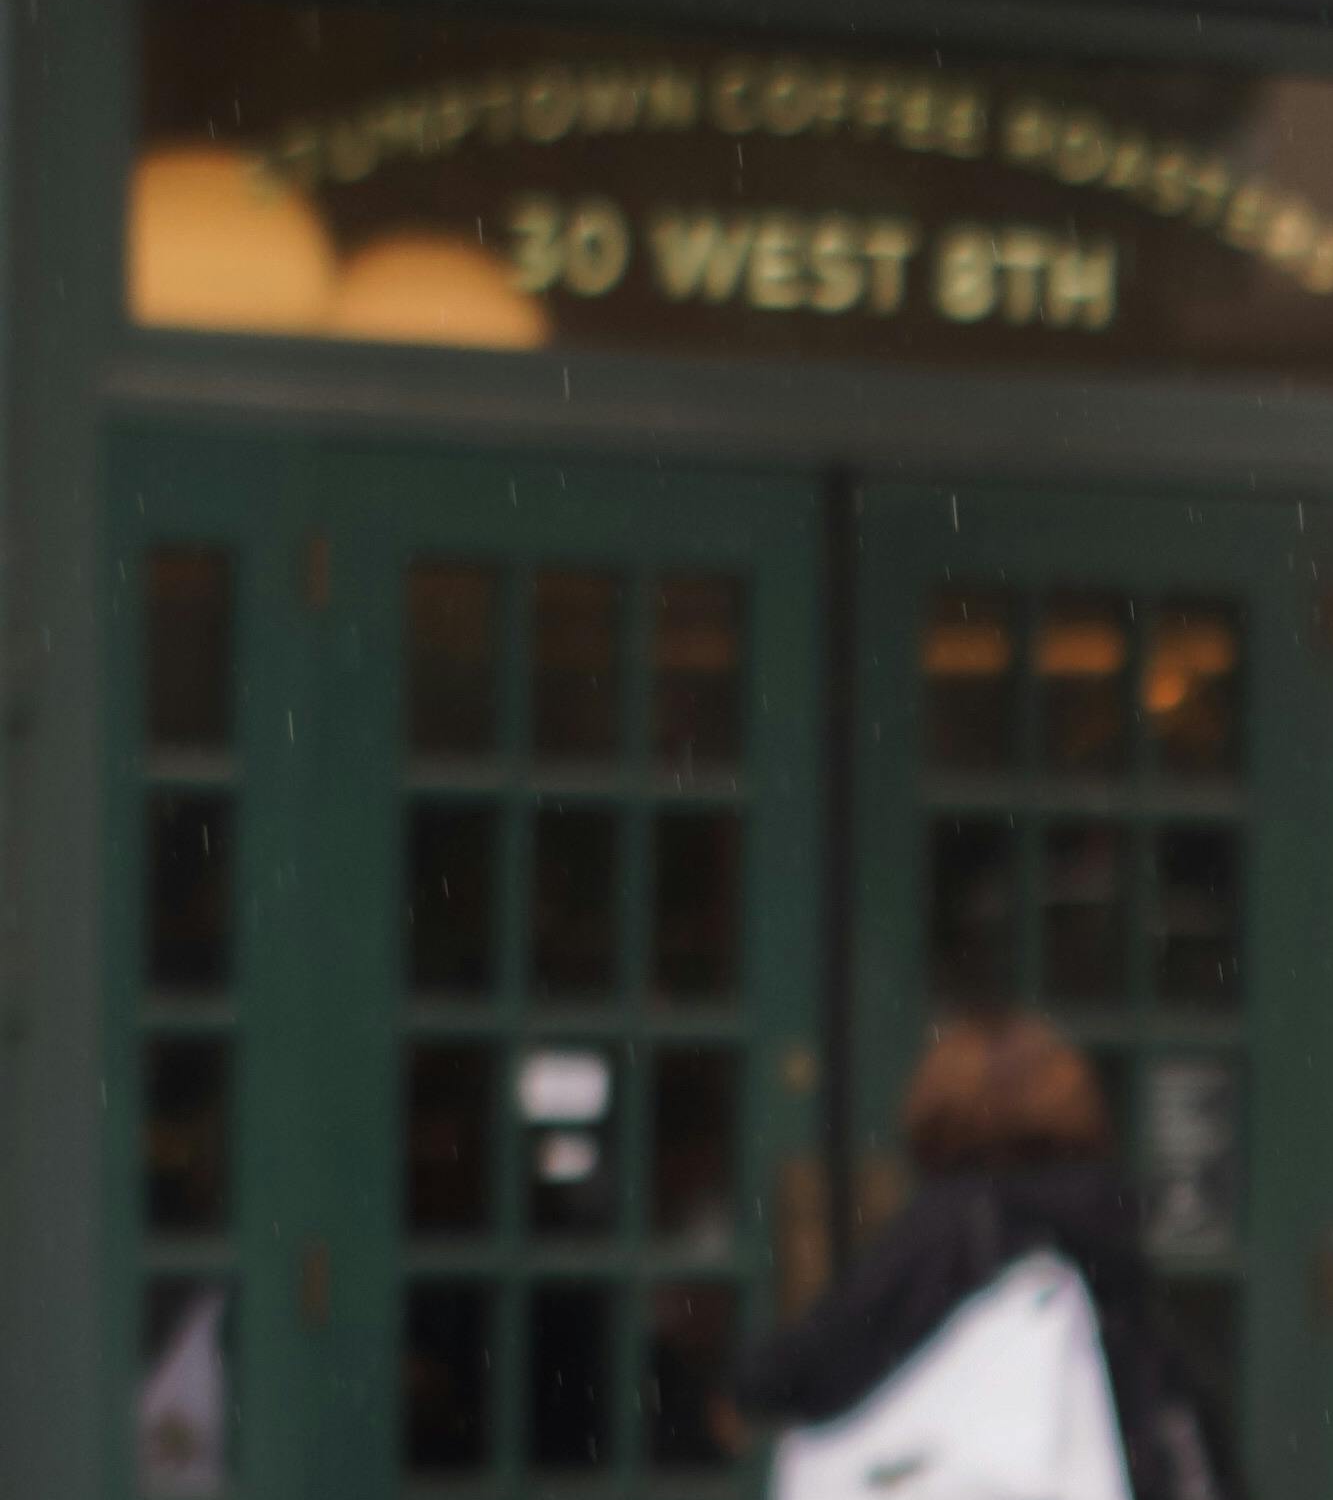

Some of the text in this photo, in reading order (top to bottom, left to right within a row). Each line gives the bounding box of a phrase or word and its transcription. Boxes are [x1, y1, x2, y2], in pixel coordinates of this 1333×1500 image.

[250, 70, 698, 190] TUMPTOWN
[706, 70, 986, 158] COFFEE
[512, 203, 1116, 328] 30 WEST 8TH
